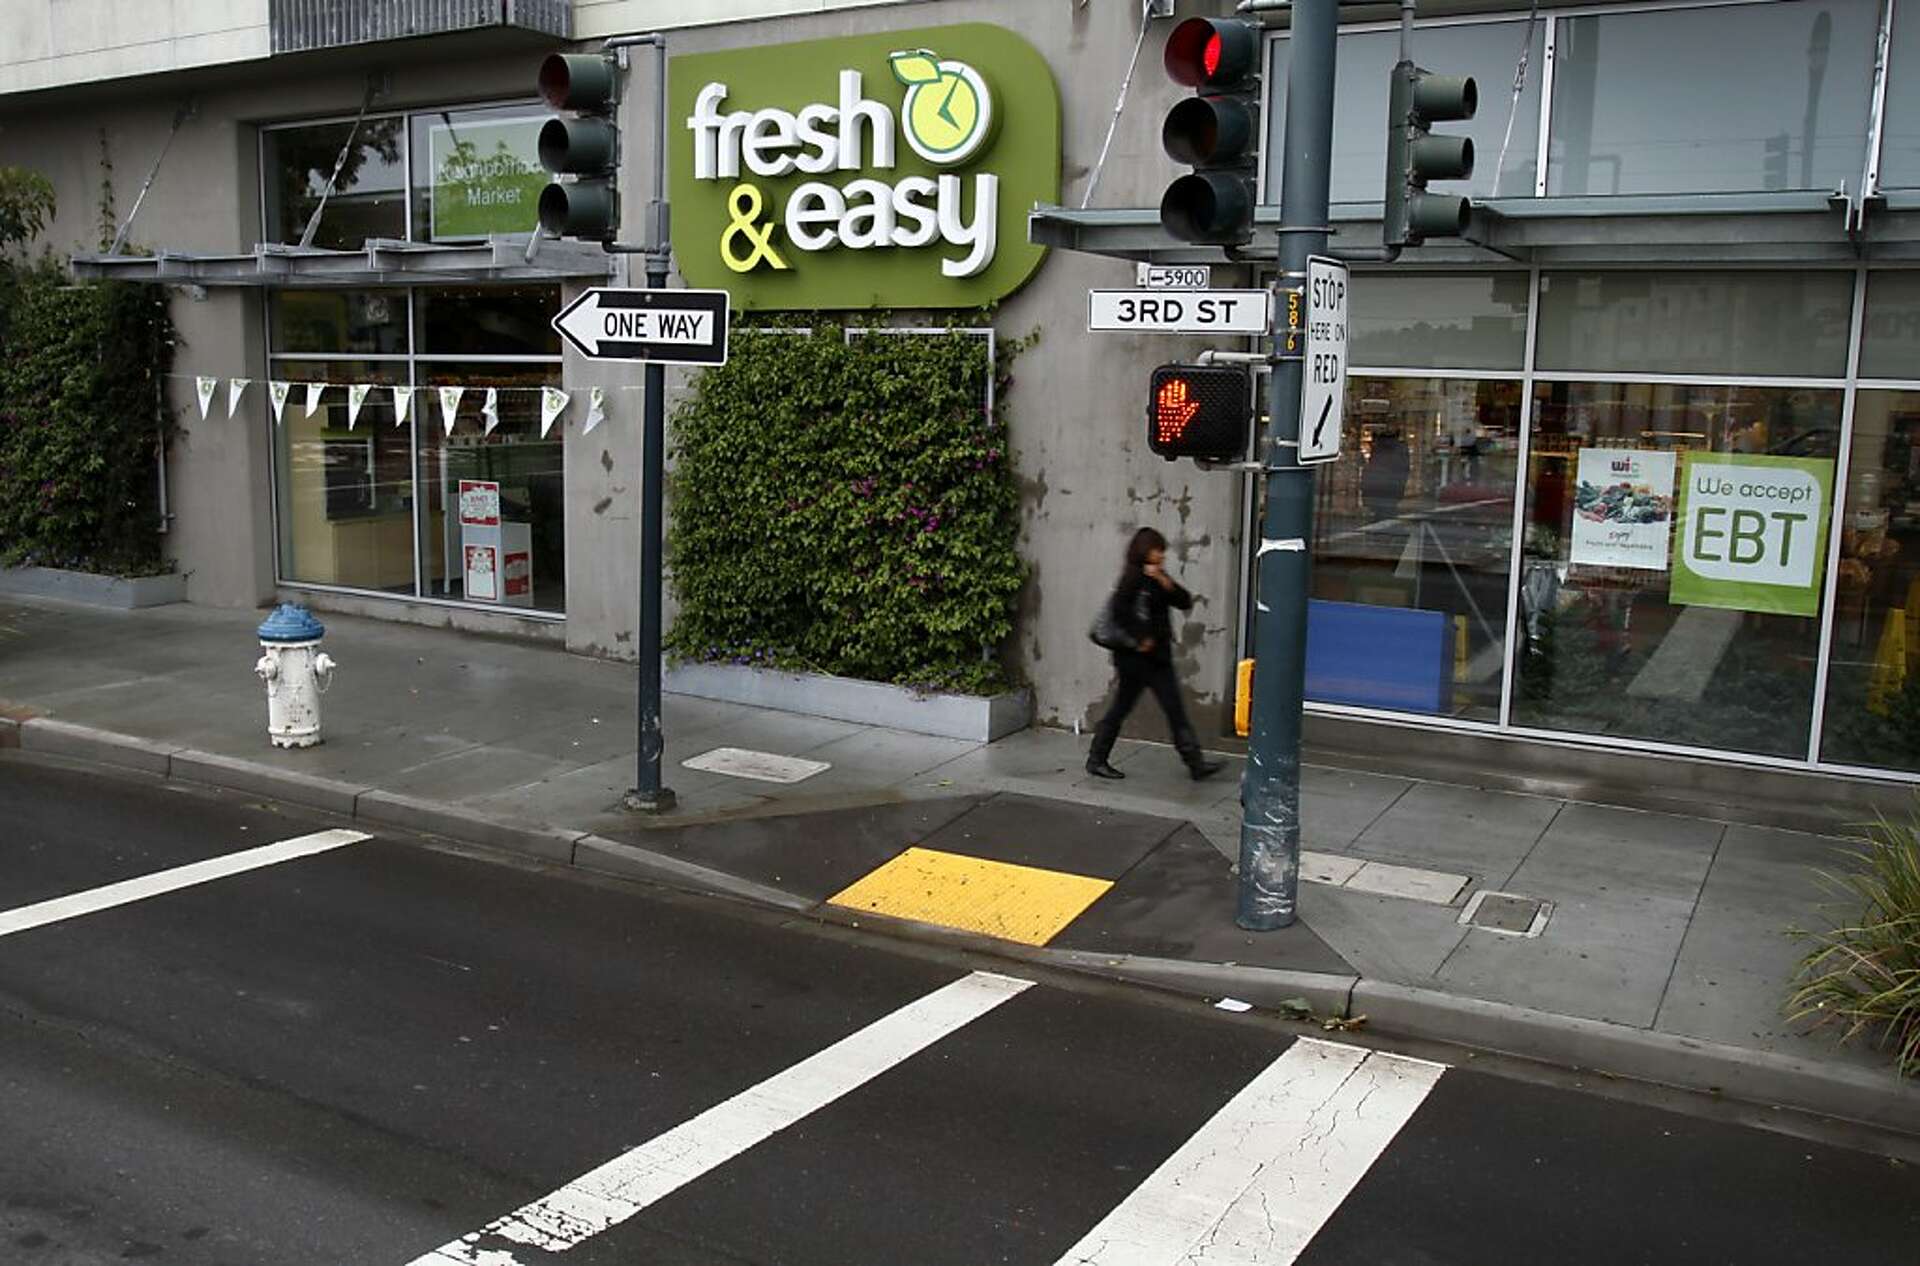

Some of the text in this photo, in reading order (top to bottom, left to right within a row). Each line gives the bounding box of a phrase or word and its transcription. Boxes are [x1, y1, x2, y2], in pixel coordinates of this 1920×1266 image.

[687, 69, 895, 180] fresh
[467, 187, 520, 206] Market
[720, 173, 998, 278] & easy
[1164, 270, 1205, 286] 5900
[1313, 277, 1345, 311] STOP
[1117, 299, 1238, 323] 3RD ST
[604, 312, 704, 340] ONE WAY
[1310, 322, 1345, 341] HERE ON
[1314, 353, 1338, 384] RED
[1697, 477, 1812, 504] We accept
[1693, 507, 1808, 567] EBT
